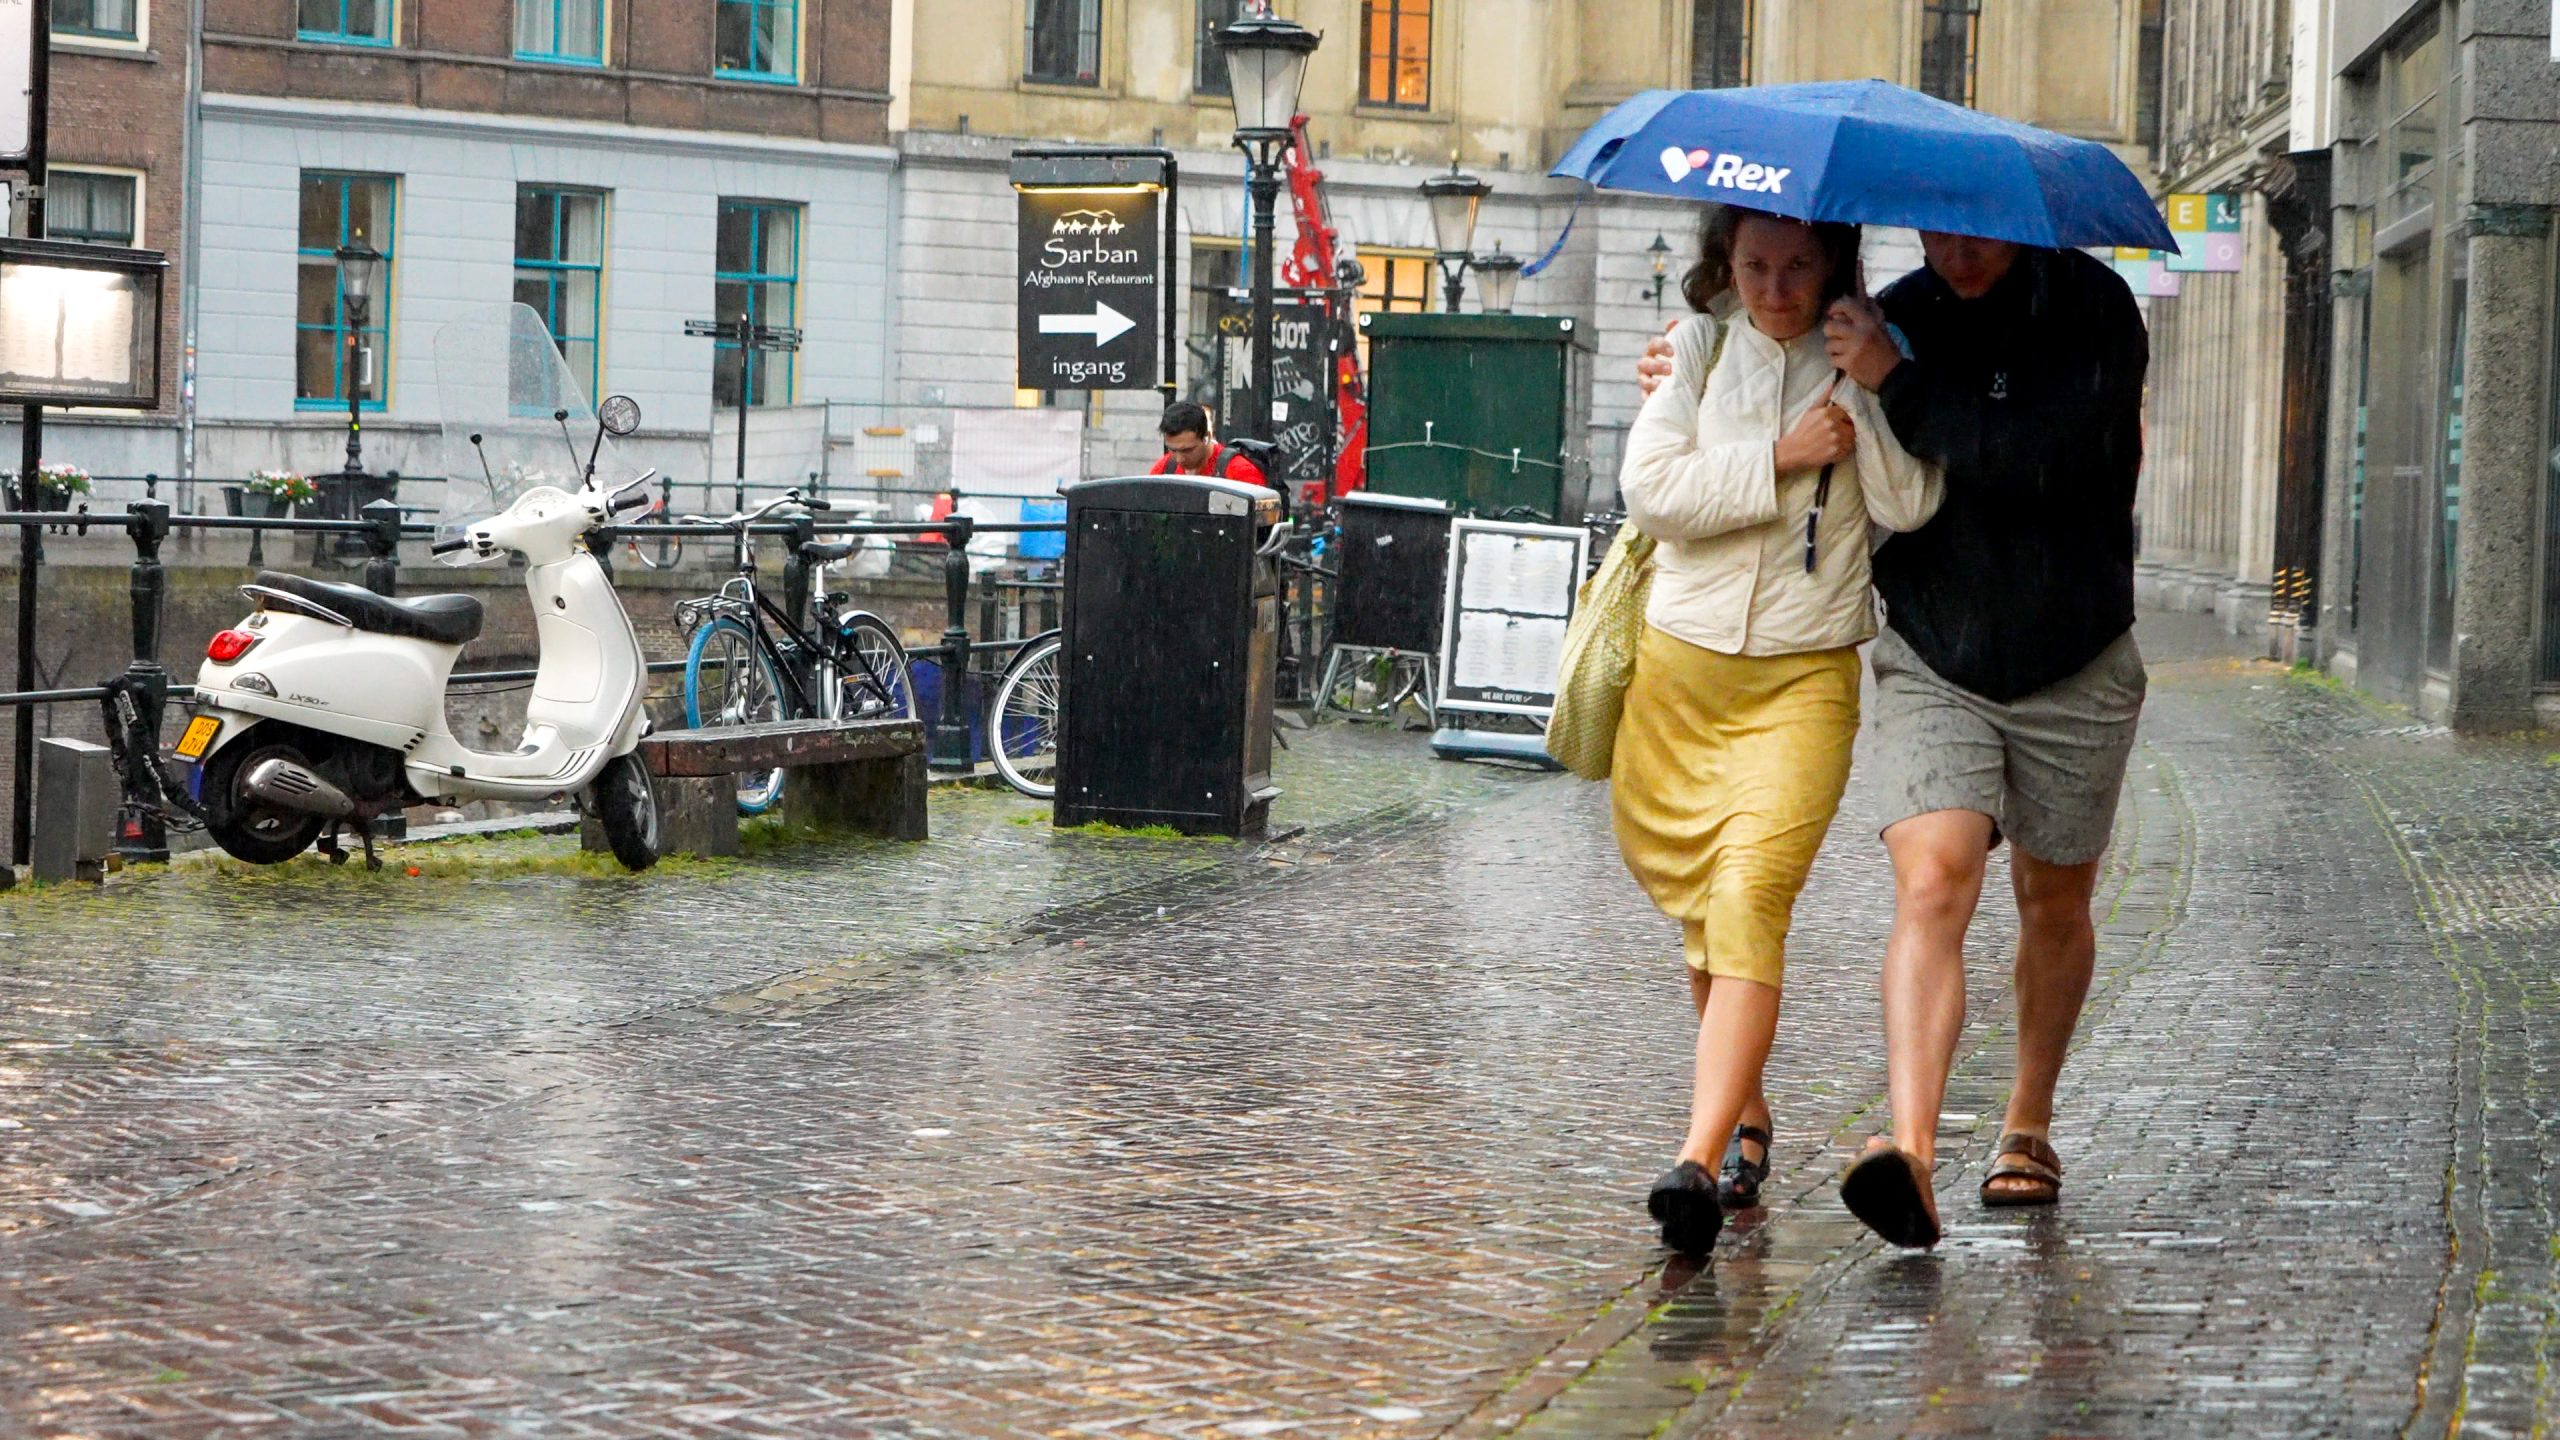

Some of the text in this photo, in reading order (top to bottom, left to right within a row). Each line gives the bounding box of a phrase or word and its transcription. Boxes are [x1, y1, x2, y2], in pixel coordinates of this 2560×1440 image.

[1706, 153, 1791, 194] Rex
[1041, 237, 1138, 268] Sarban
[1024, 270, 1154, 288] Afghaans Restaurant
[1271, 321, 1310, 349] JOT
[1053, 355, 1126, 383] ingang
[1481, 691, 1491, 700] WE
[1492, 692, 1503, 701] ARE
